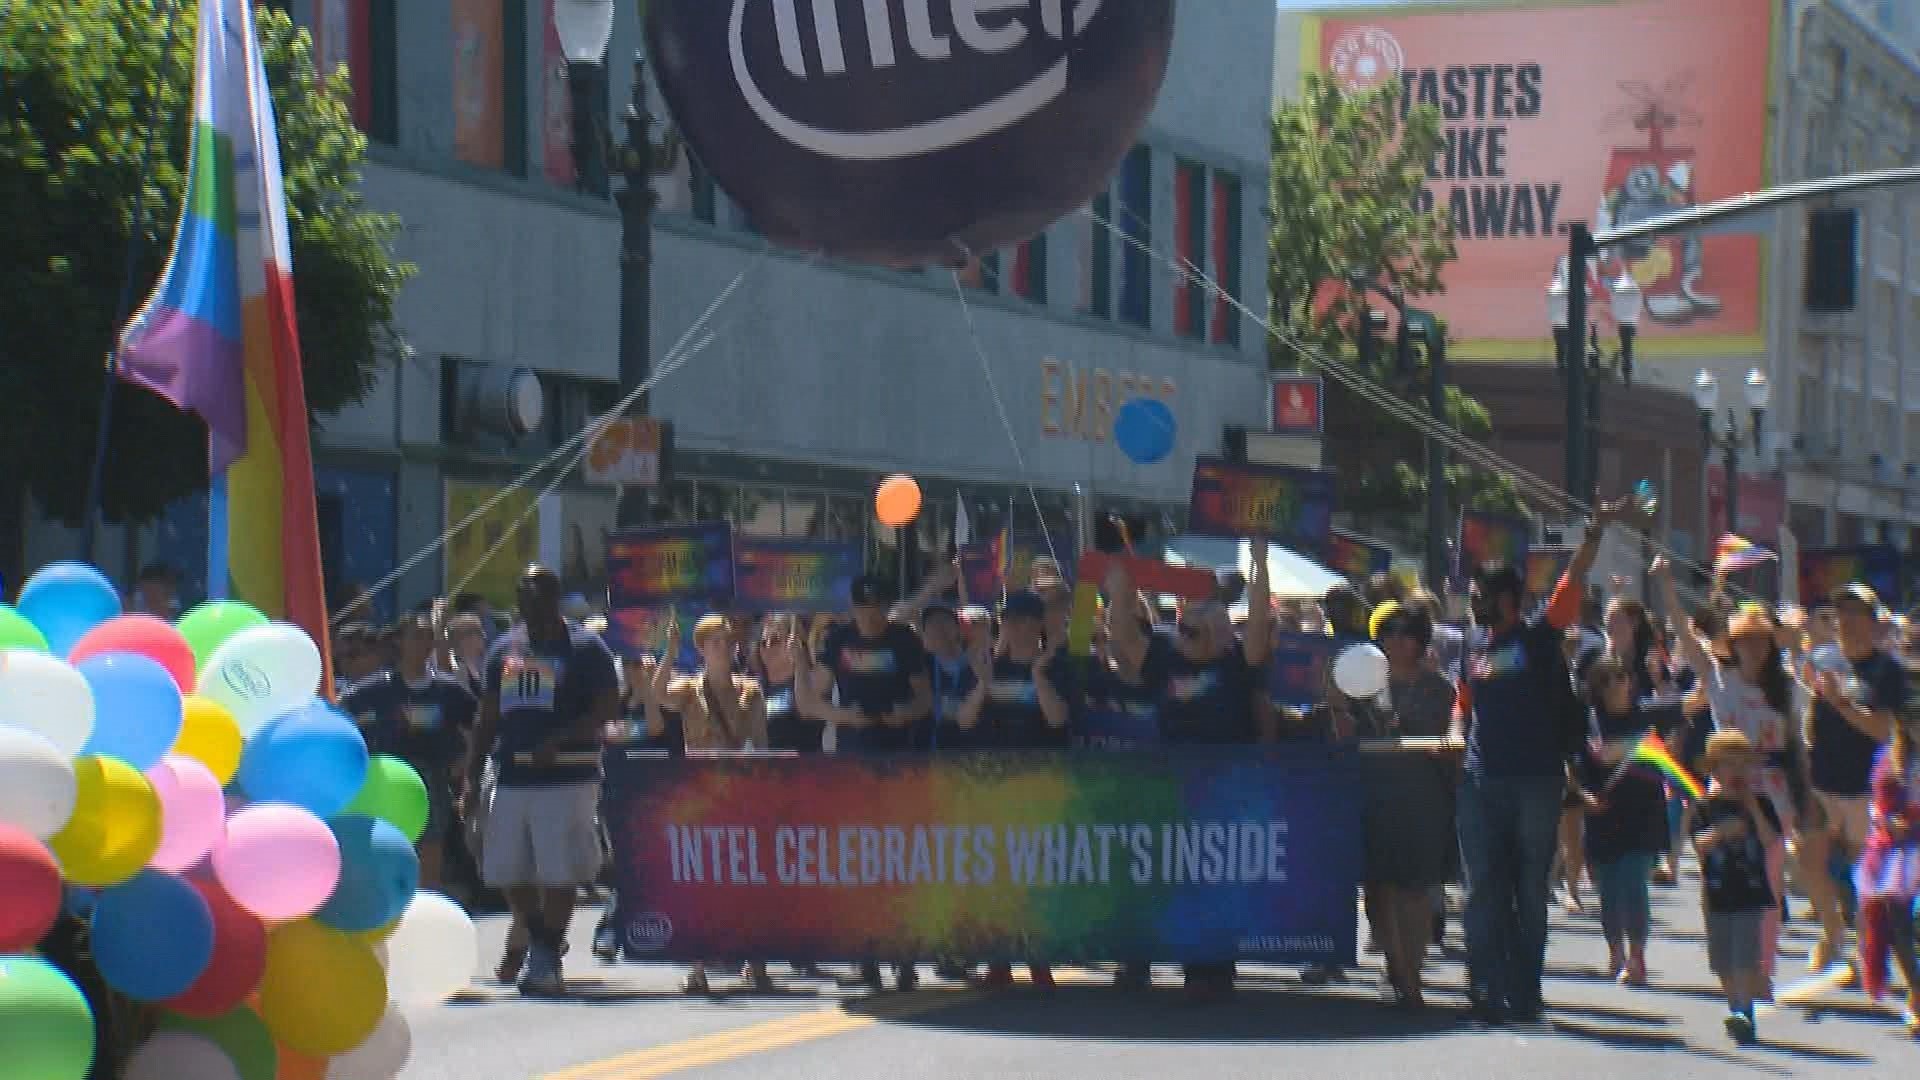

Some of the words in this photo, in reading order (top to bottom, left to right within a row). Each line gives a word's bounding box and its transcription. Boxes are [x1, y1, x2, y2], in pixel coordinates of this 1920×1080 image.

[1398, 64, 1543, 121] TASTES
[1425, 126, 1508, 180] LIKE
[1448, 182, 1569, 241] AWAY.
[1040, 356, 1177, 446] EMB
[668, 823, 768, 885] INTEL
[775, 823, 996, 886] CELEBRATES
[1004, 821, 1153, 886] WHAT'S
[1161, 819, 1289, 884] INSIDE
